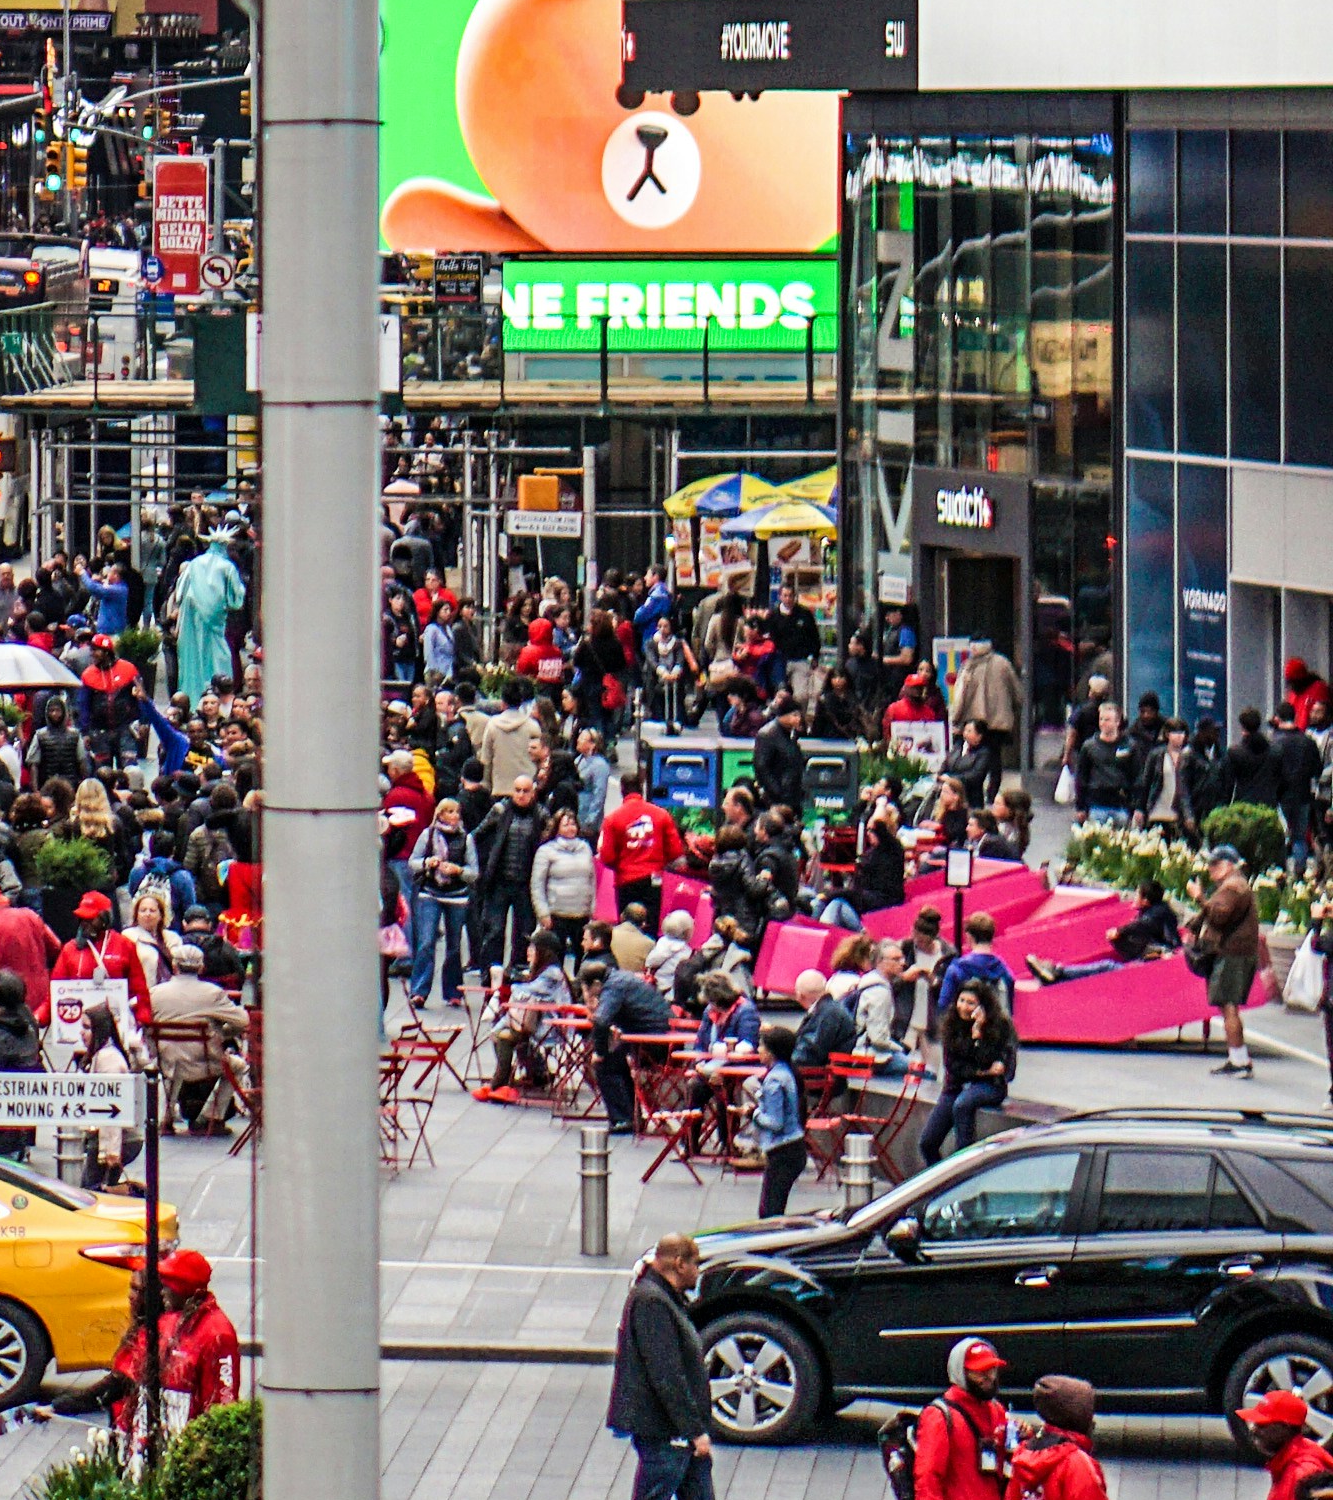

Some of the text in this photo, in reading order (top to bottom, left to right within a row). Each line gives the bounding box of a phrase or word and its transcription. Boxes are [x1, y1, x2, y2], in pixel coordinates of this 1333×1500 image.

[72, 15, 108, 29] PRIME
[721, 21, 791, 61] #YOURMOVE
[158, 194, 204, 209] BETTE
[155, 209, 206, 222] MIDLER
[158, 223, 201, 238] HELLO,
[159, 236, 202, 251] DOLLY!
[576, 281, 816, 331] FRIENDS
[58, 1003, 83, 1020] $29
[52, 1079, 86, 1097] FLOW
[90, 1079, 123, 1098] ZONE
[7, 1101, 55, 1118] MOVING
